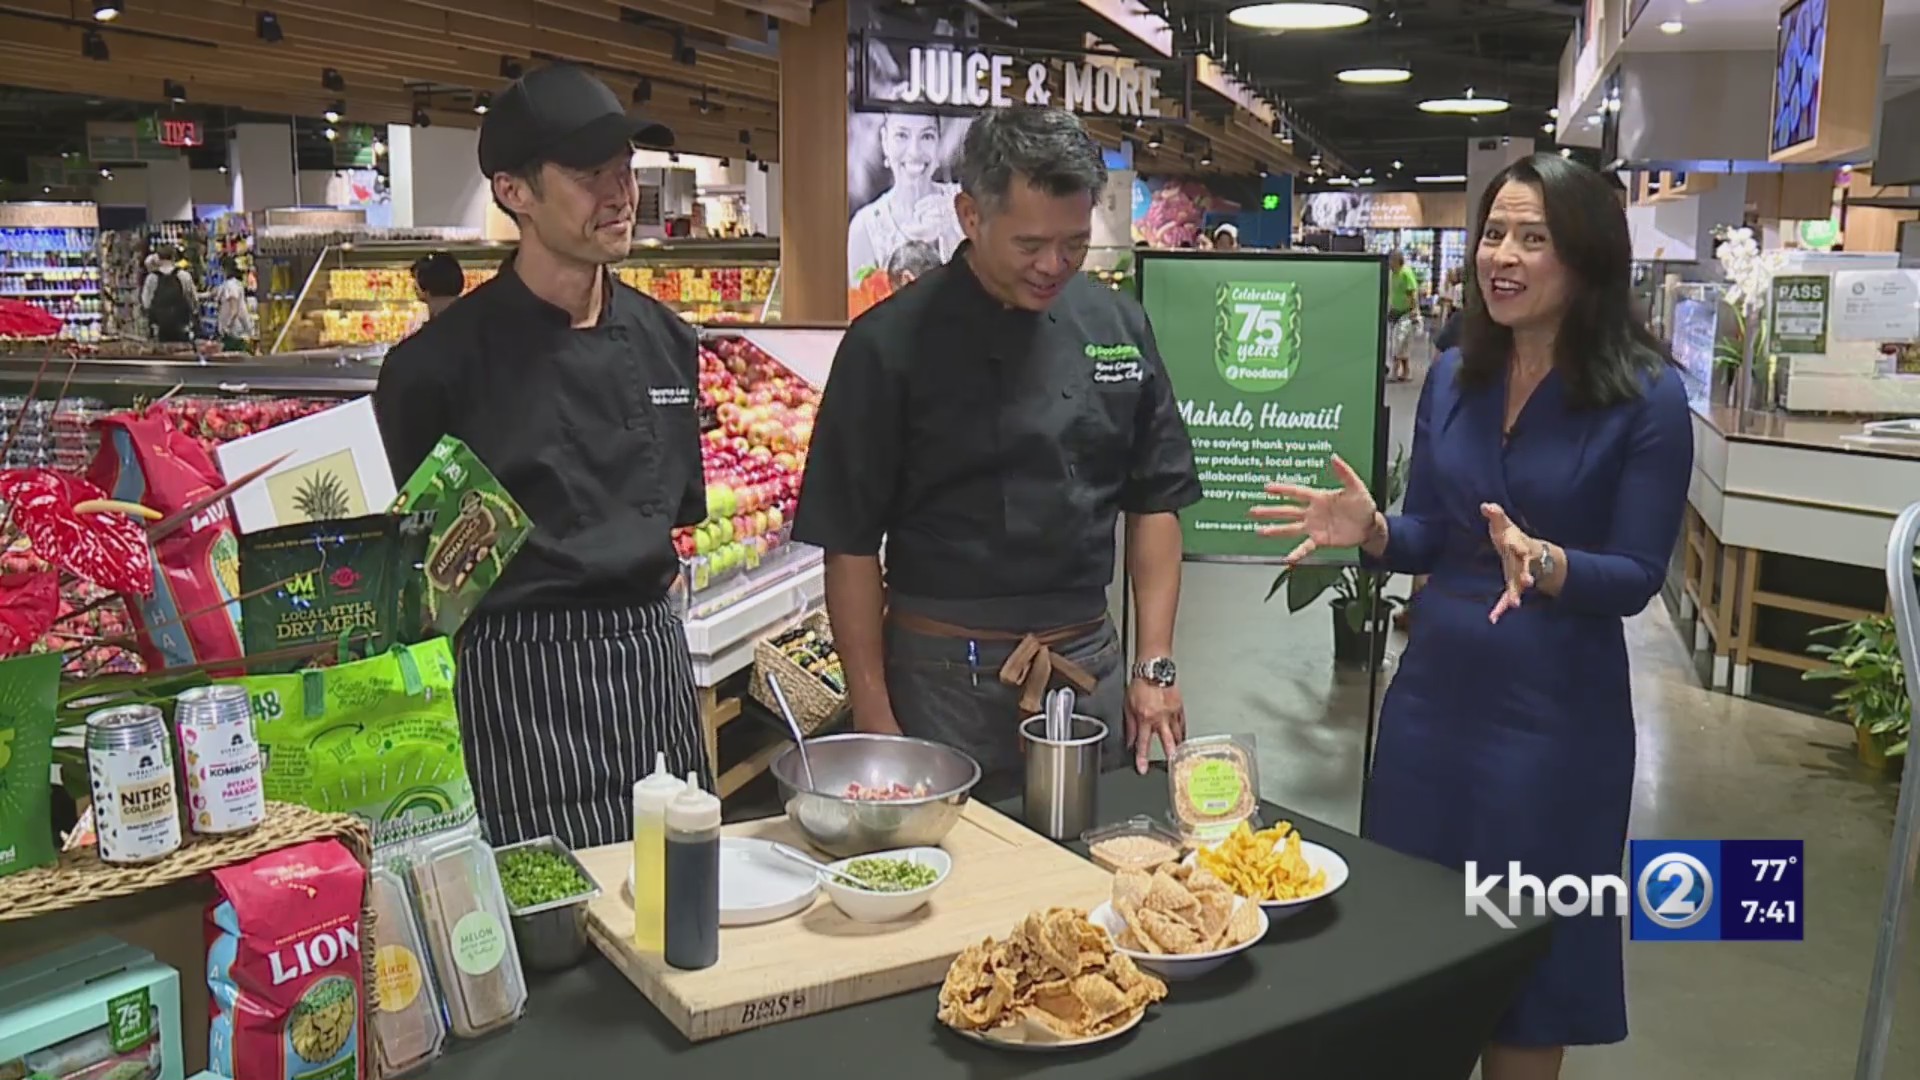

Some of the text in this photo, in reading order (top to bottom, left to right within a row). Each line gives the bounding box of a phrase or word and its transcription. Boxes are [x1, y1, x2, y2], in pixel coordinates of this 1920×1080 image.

[902, 47, 1162, 117] JUICE & MORE
[1231, 287, 1286, 306] Celebrating
[1779, 284, 1823, 300] PASS
[1234, 303, 1283, 346] 75
[1237, 343, 1279, 363] years
[1238, 367, 1289, 379] Foodland
[1177, 399, 1343, 431] Mahalo, Hawaii!
[1213, 437, 1249, 452] saying
[1251, 437, 1283, 450] thank
[1285, 441, 1306, 453] you
[1307, 439, 1332, 451] with
[1194, 454, 1325, 468] ew products, local artist
[1195, 520, 1219, 530] Learn
[1220, 522, 1242, 531] more
[281, 601, 373, 622] LOCAL-STYLE
[276, 611, 377, 639] DRY MEIN
[251, 691, 281, 720] 48
[120, 782, 172, 806] NITRO
[123, 797, 173, 815] COLD BREW
[460, 926, 493, 945] MELON
[267, 920, 361, 986] LION
[116, 1003, 142, 1028] 75
